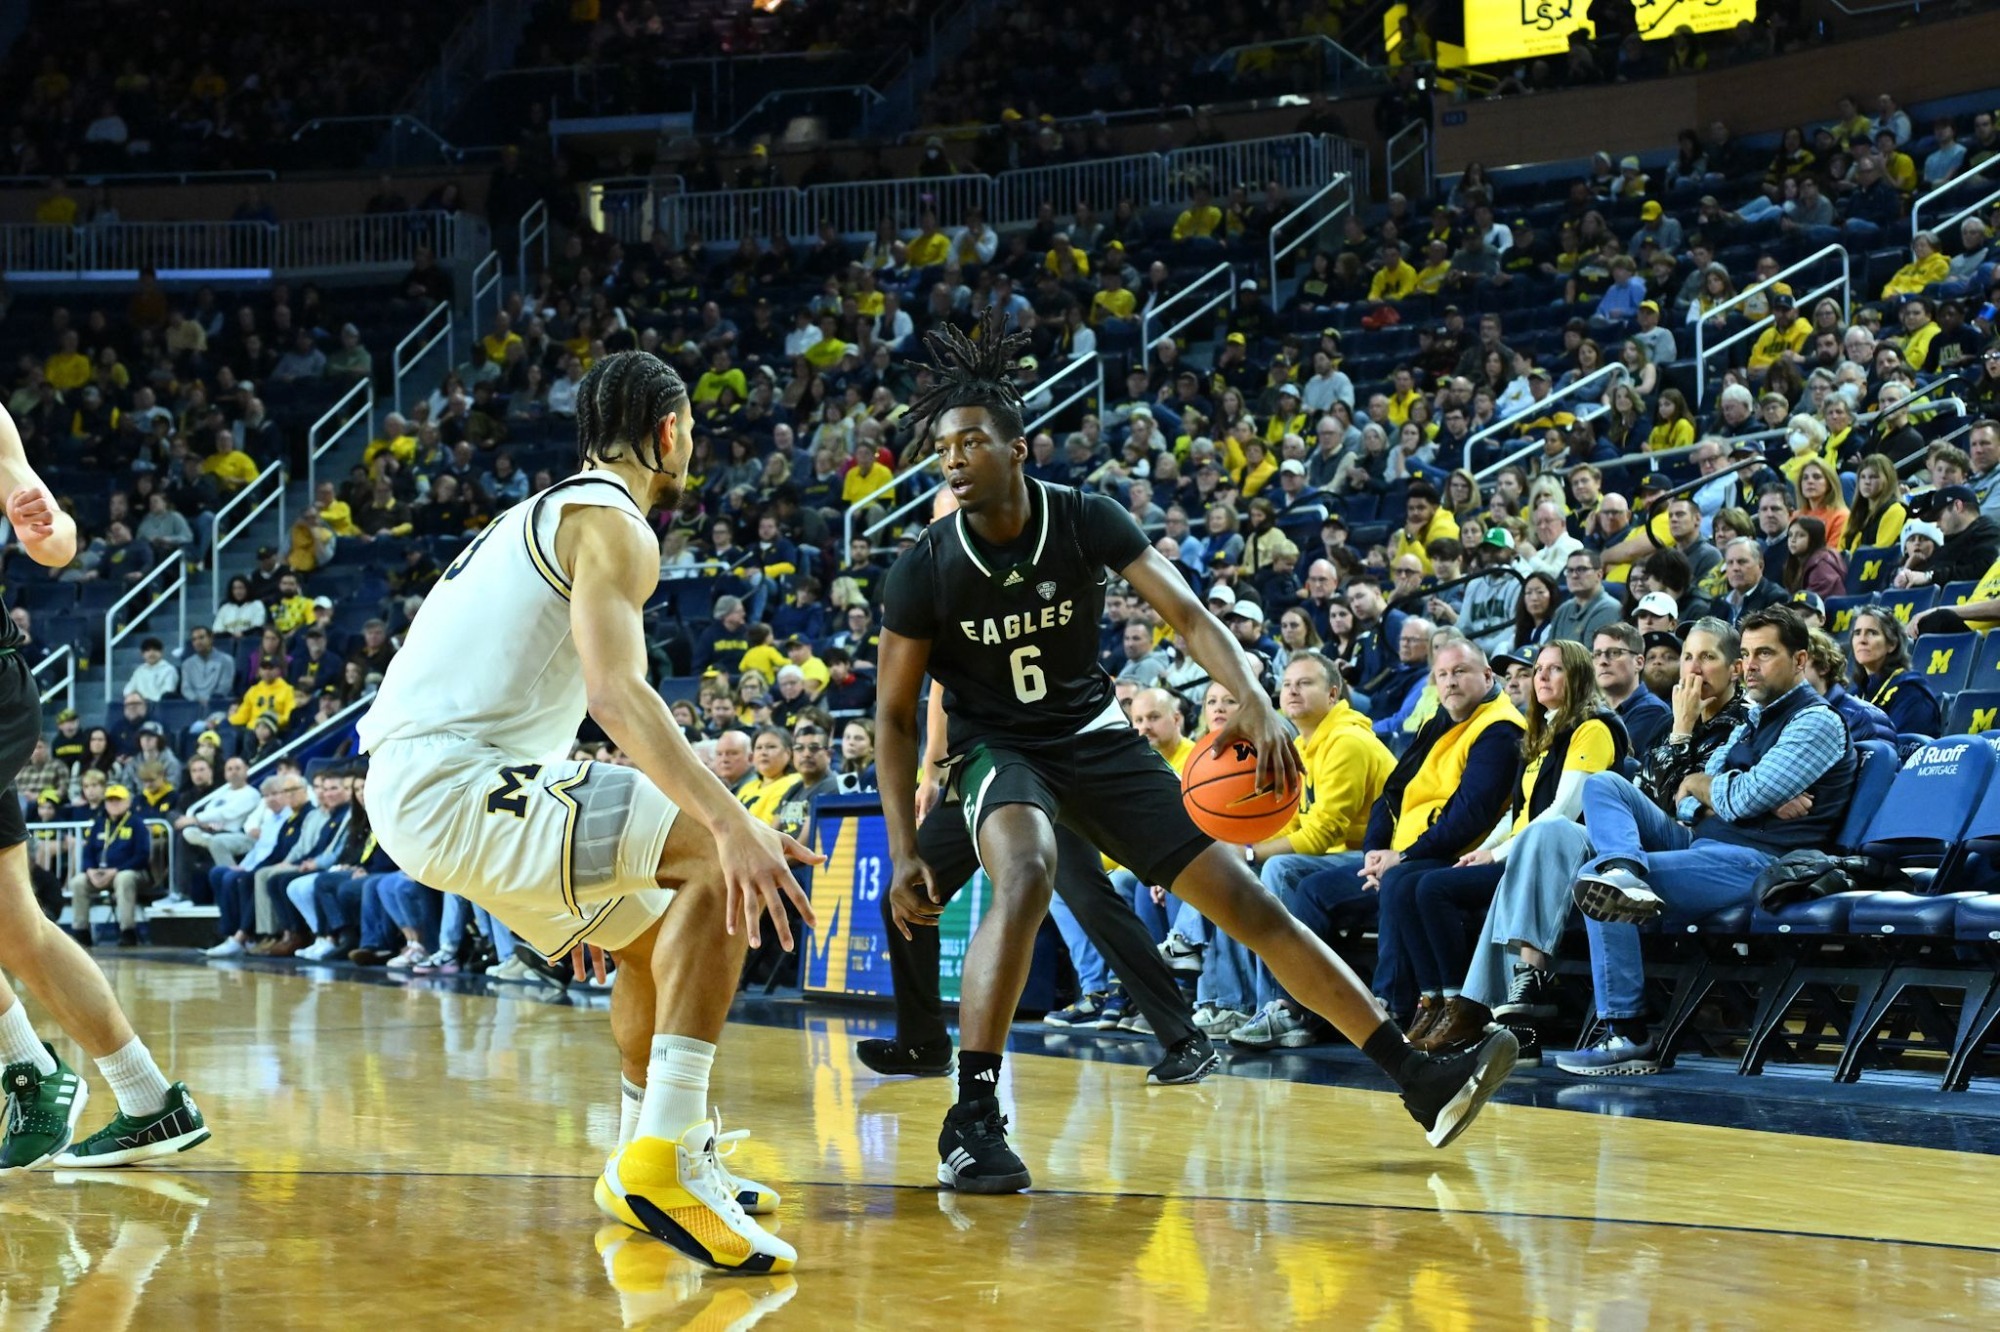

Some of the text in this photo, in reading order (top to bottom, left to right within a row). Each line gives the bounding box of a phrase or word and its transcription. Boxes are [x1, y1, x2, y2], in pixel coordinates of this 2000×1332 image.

[1860, 560, 1883, 581] M
[960, 600, 1073, 645] EAGLES
[1009, 645, 1047, 704] 6
[1926, 648, 1954, 675] M
[1968, 707, 1998, 735] M
[1922, 744, 1969, 764] Ruoff
[1917, 764, 1958, 776] MORTGAGE
[487, 763, 542, 818] M
[858, 856, 881, 901] 13
